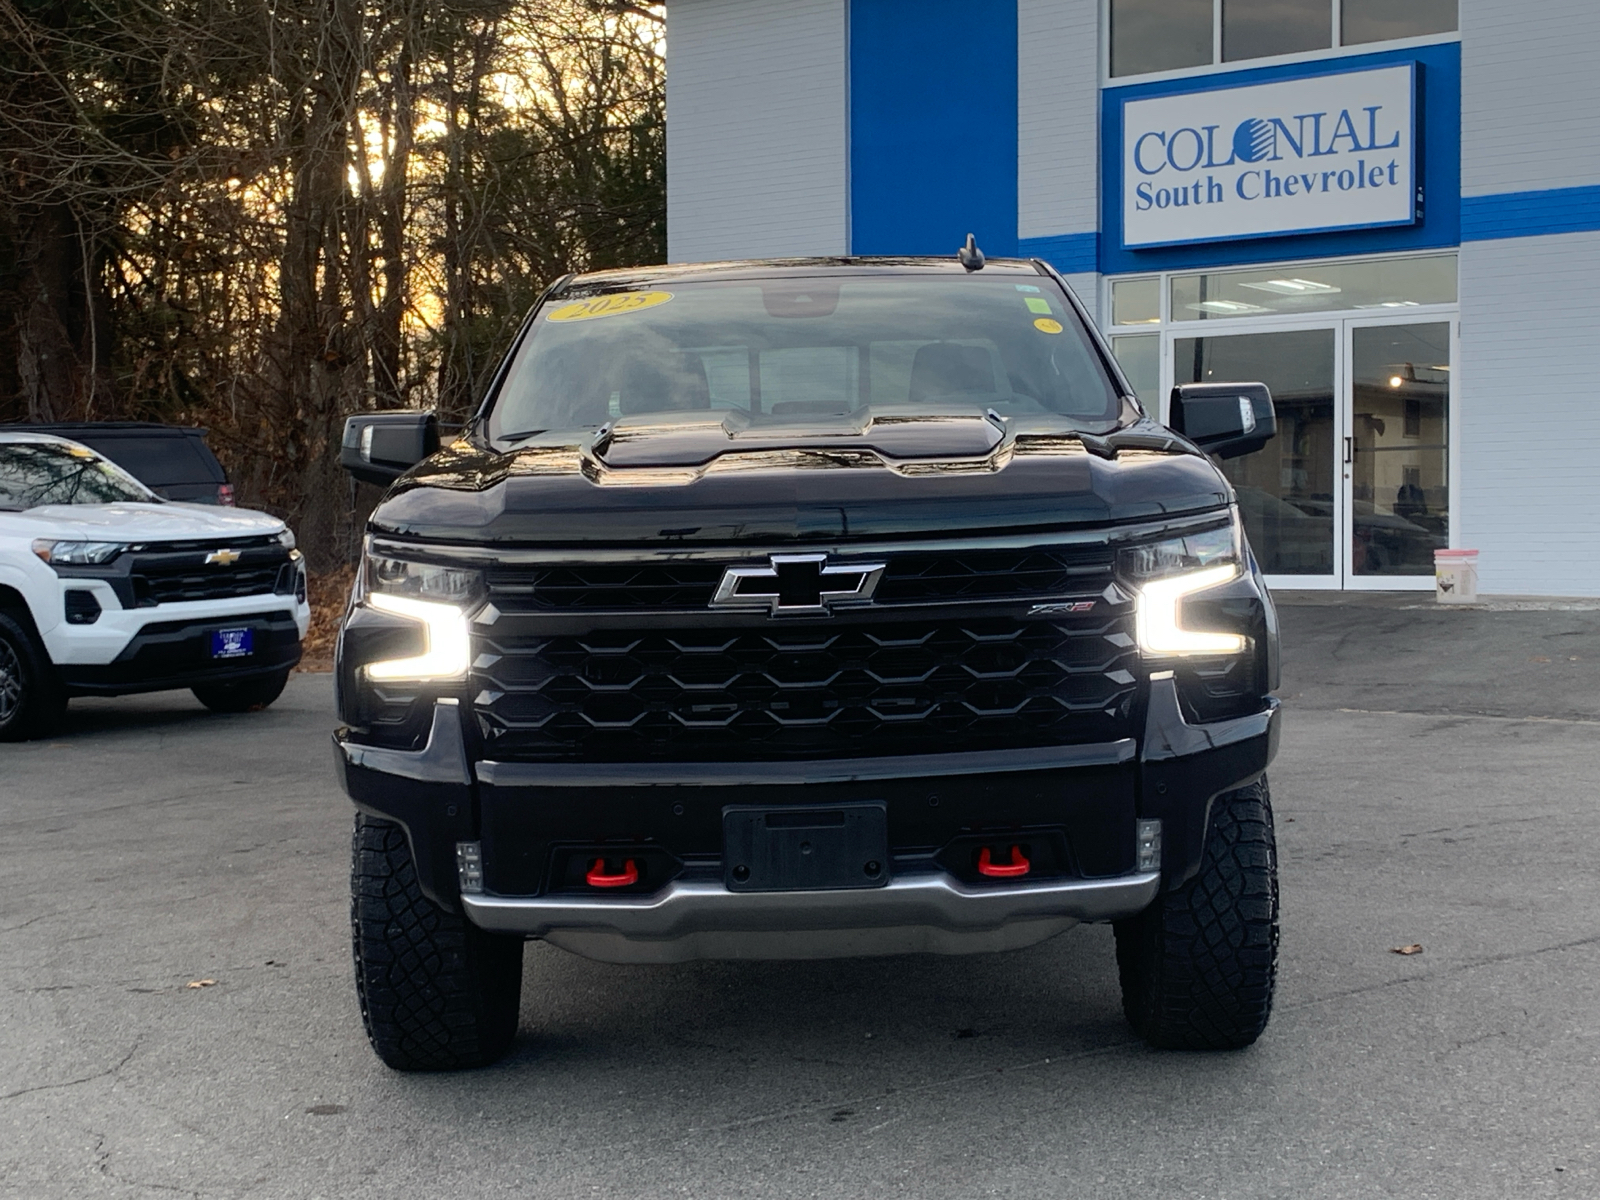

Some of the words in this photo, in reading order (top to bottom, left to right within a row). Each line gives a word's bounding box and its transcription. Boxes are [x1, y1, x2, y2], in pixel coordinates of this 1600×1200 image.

[1134, 105, 1400, 176] COLONIAL
[1135, 175, 1224, 212] South
[1235, 158, 1400, 201] Chevrolet
[565, 293, 653, 319] 2025
